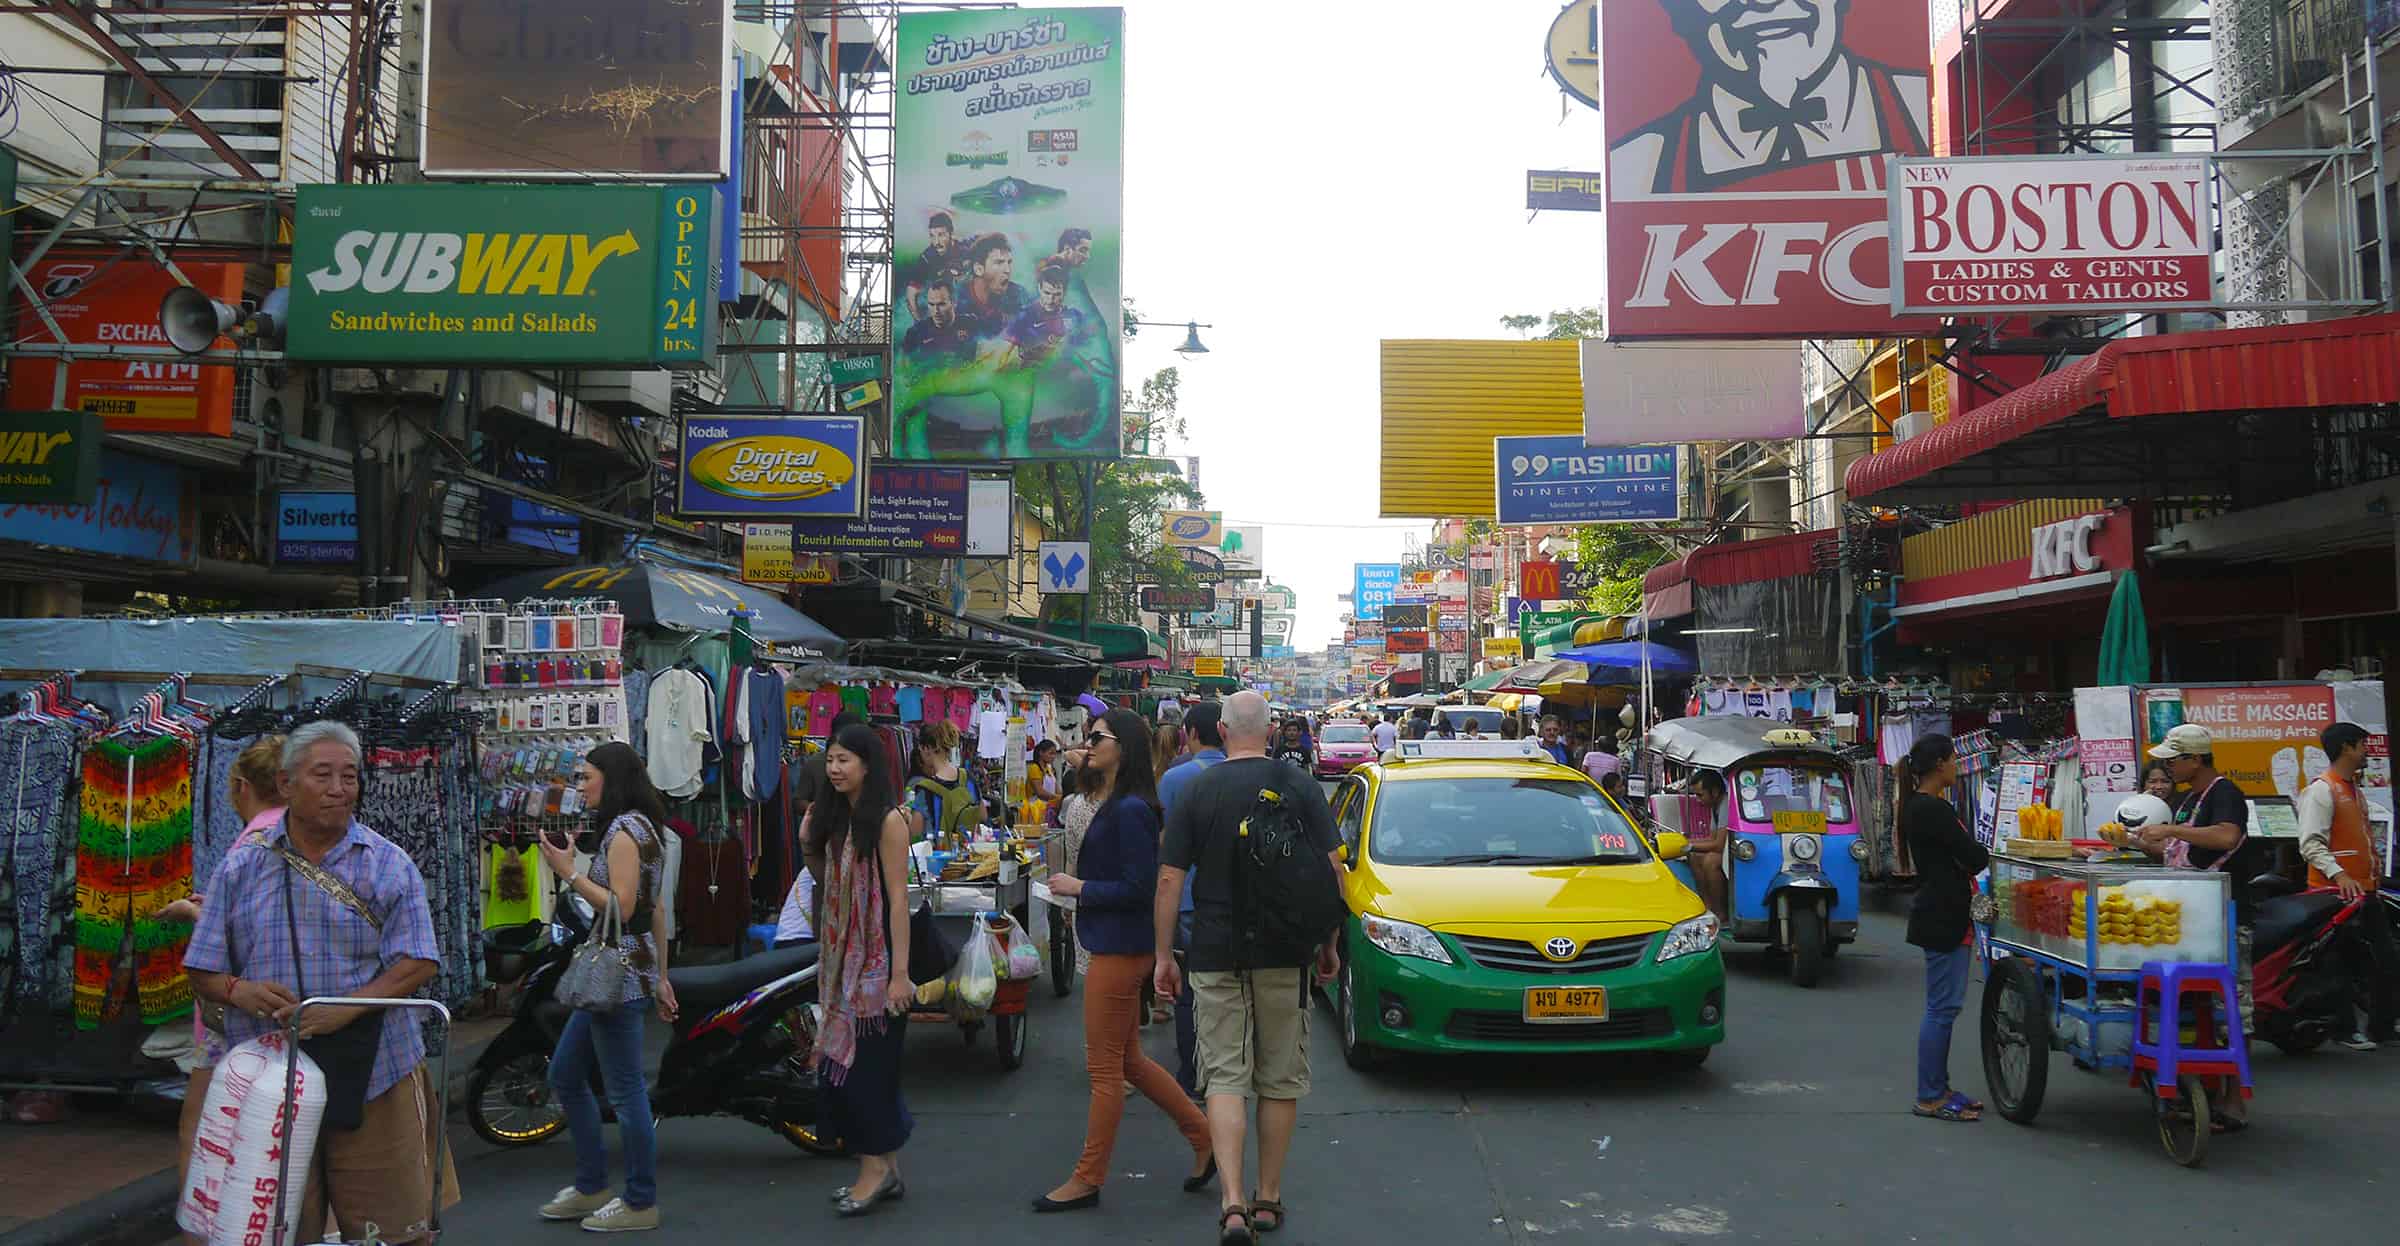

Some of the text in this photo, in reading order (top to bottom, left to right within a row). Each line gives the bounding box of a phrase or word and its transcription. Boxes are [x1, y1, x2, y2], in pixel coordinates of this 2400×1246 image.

[1905, 167, 1953, 183] NEW
[1905, 180, 2202, 254] BOSTON
[306, 229, 640, 296] SUBWAY
[1623, 220, 1892, 308] KFC
[1931, 259, 2182, 282] LADIES & GENTS
[1925, 280, 2190, 304] CUSTOM TAILORS
[330, 310, 598, 334] Sandwiches and Salads
[664, 298, 697, 330] 24
[97, 323, 168, 342] EXCHA
[664, 336, 696, 352] hrs.
[689, 426, 730, 439] Kodak
[736, 446, 820, 471] Digital
[1513, 483, 1672, 497] NINETY NINE
[799, 534, 924, 549] Tourist Information Center
[932, 533, 956, 544] Here
[283, 543, 307, 557] 925
[2029, 514, 2105, 580] KFC
[749, 569, 761, 578] IN
[764, 569, 776, 579] 20
[1363, 590, 1393, 602] 081
[2247, 703, 2329, 723] MASSAGE
[2231, 726, 2282, 740] Healing
[2285, 725, 2319, 738] Arts
[2082, 740, 2129, 751] Cocktail
[1566, 992, 1601, 1007] 4977
